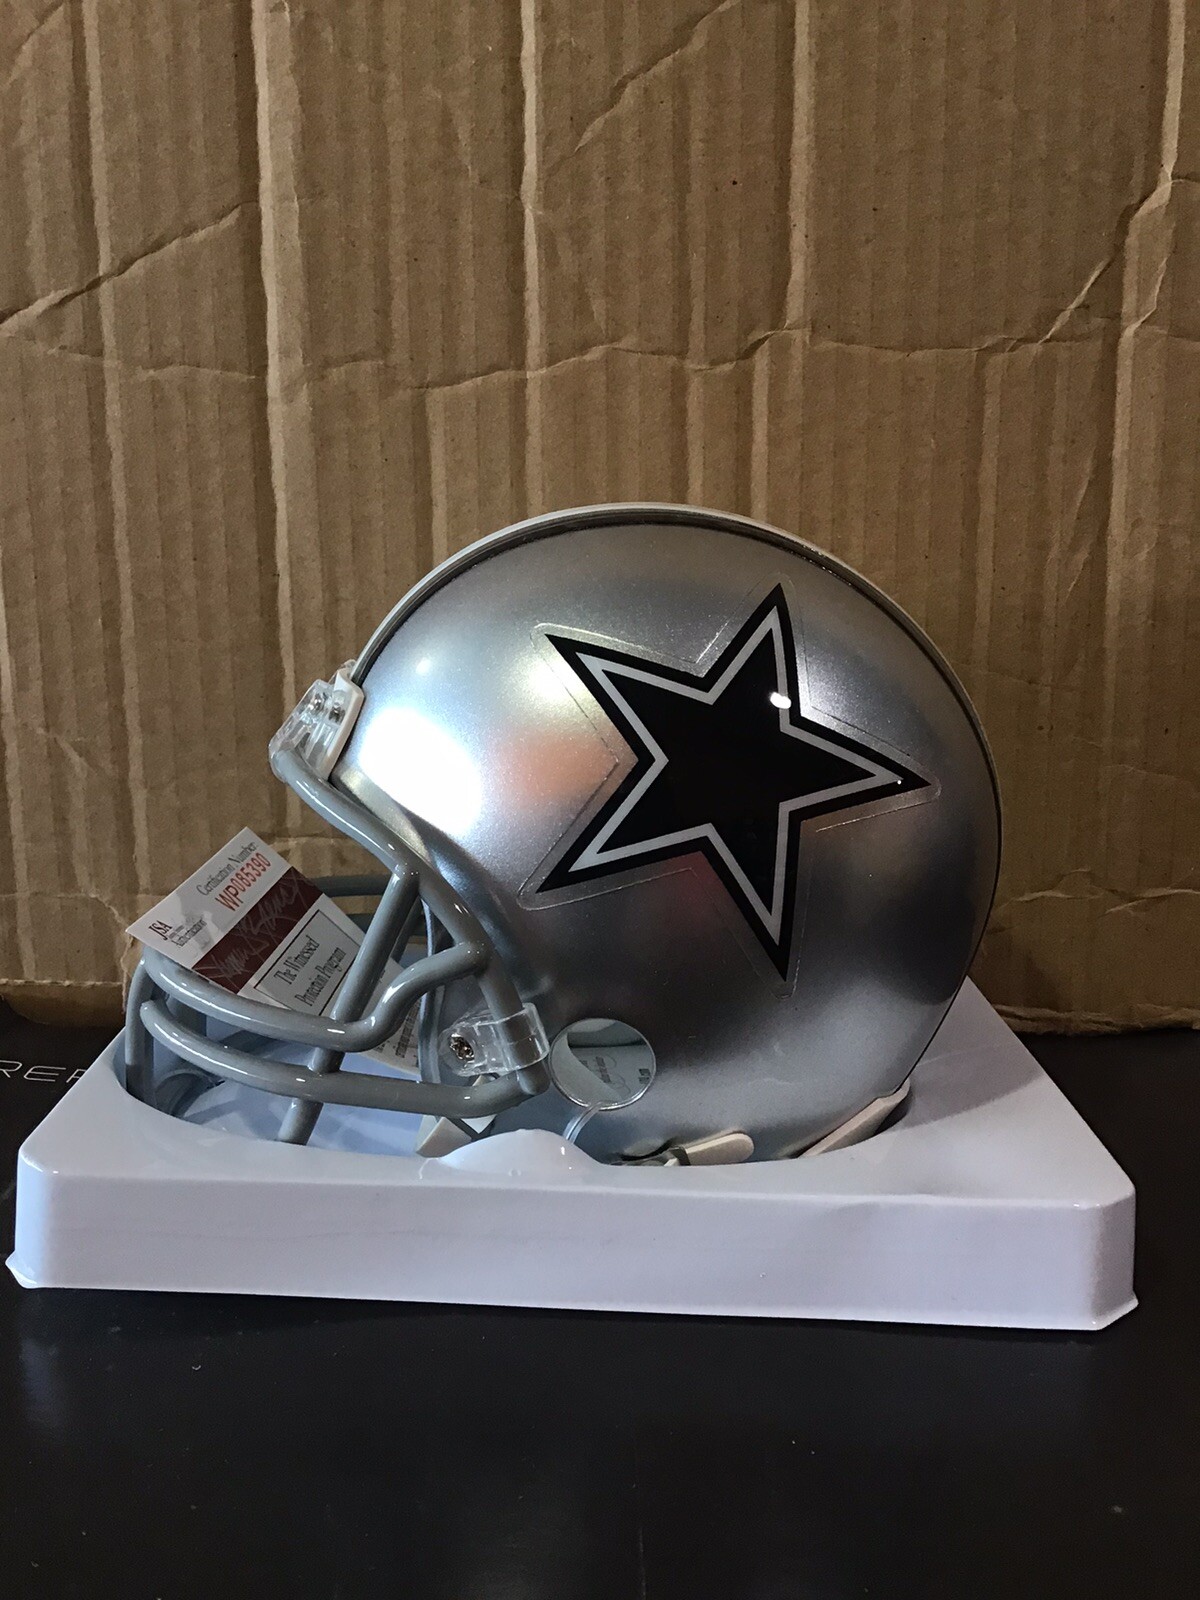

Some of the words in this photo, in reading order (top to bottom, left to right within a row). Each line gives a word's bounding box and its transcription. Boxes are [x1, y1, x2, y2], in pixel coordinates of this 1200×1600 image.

[197, 862, 236, 896] Certification
[215, 852, 271, 911] WP085390
[149, 920, 172, 940] JSA
[283, 934, 320, 971] Witnessed
[274, 970, 297, 985] The
[295, 974, 328, 1007] Protection
[315, 947, 346, 978] Program
